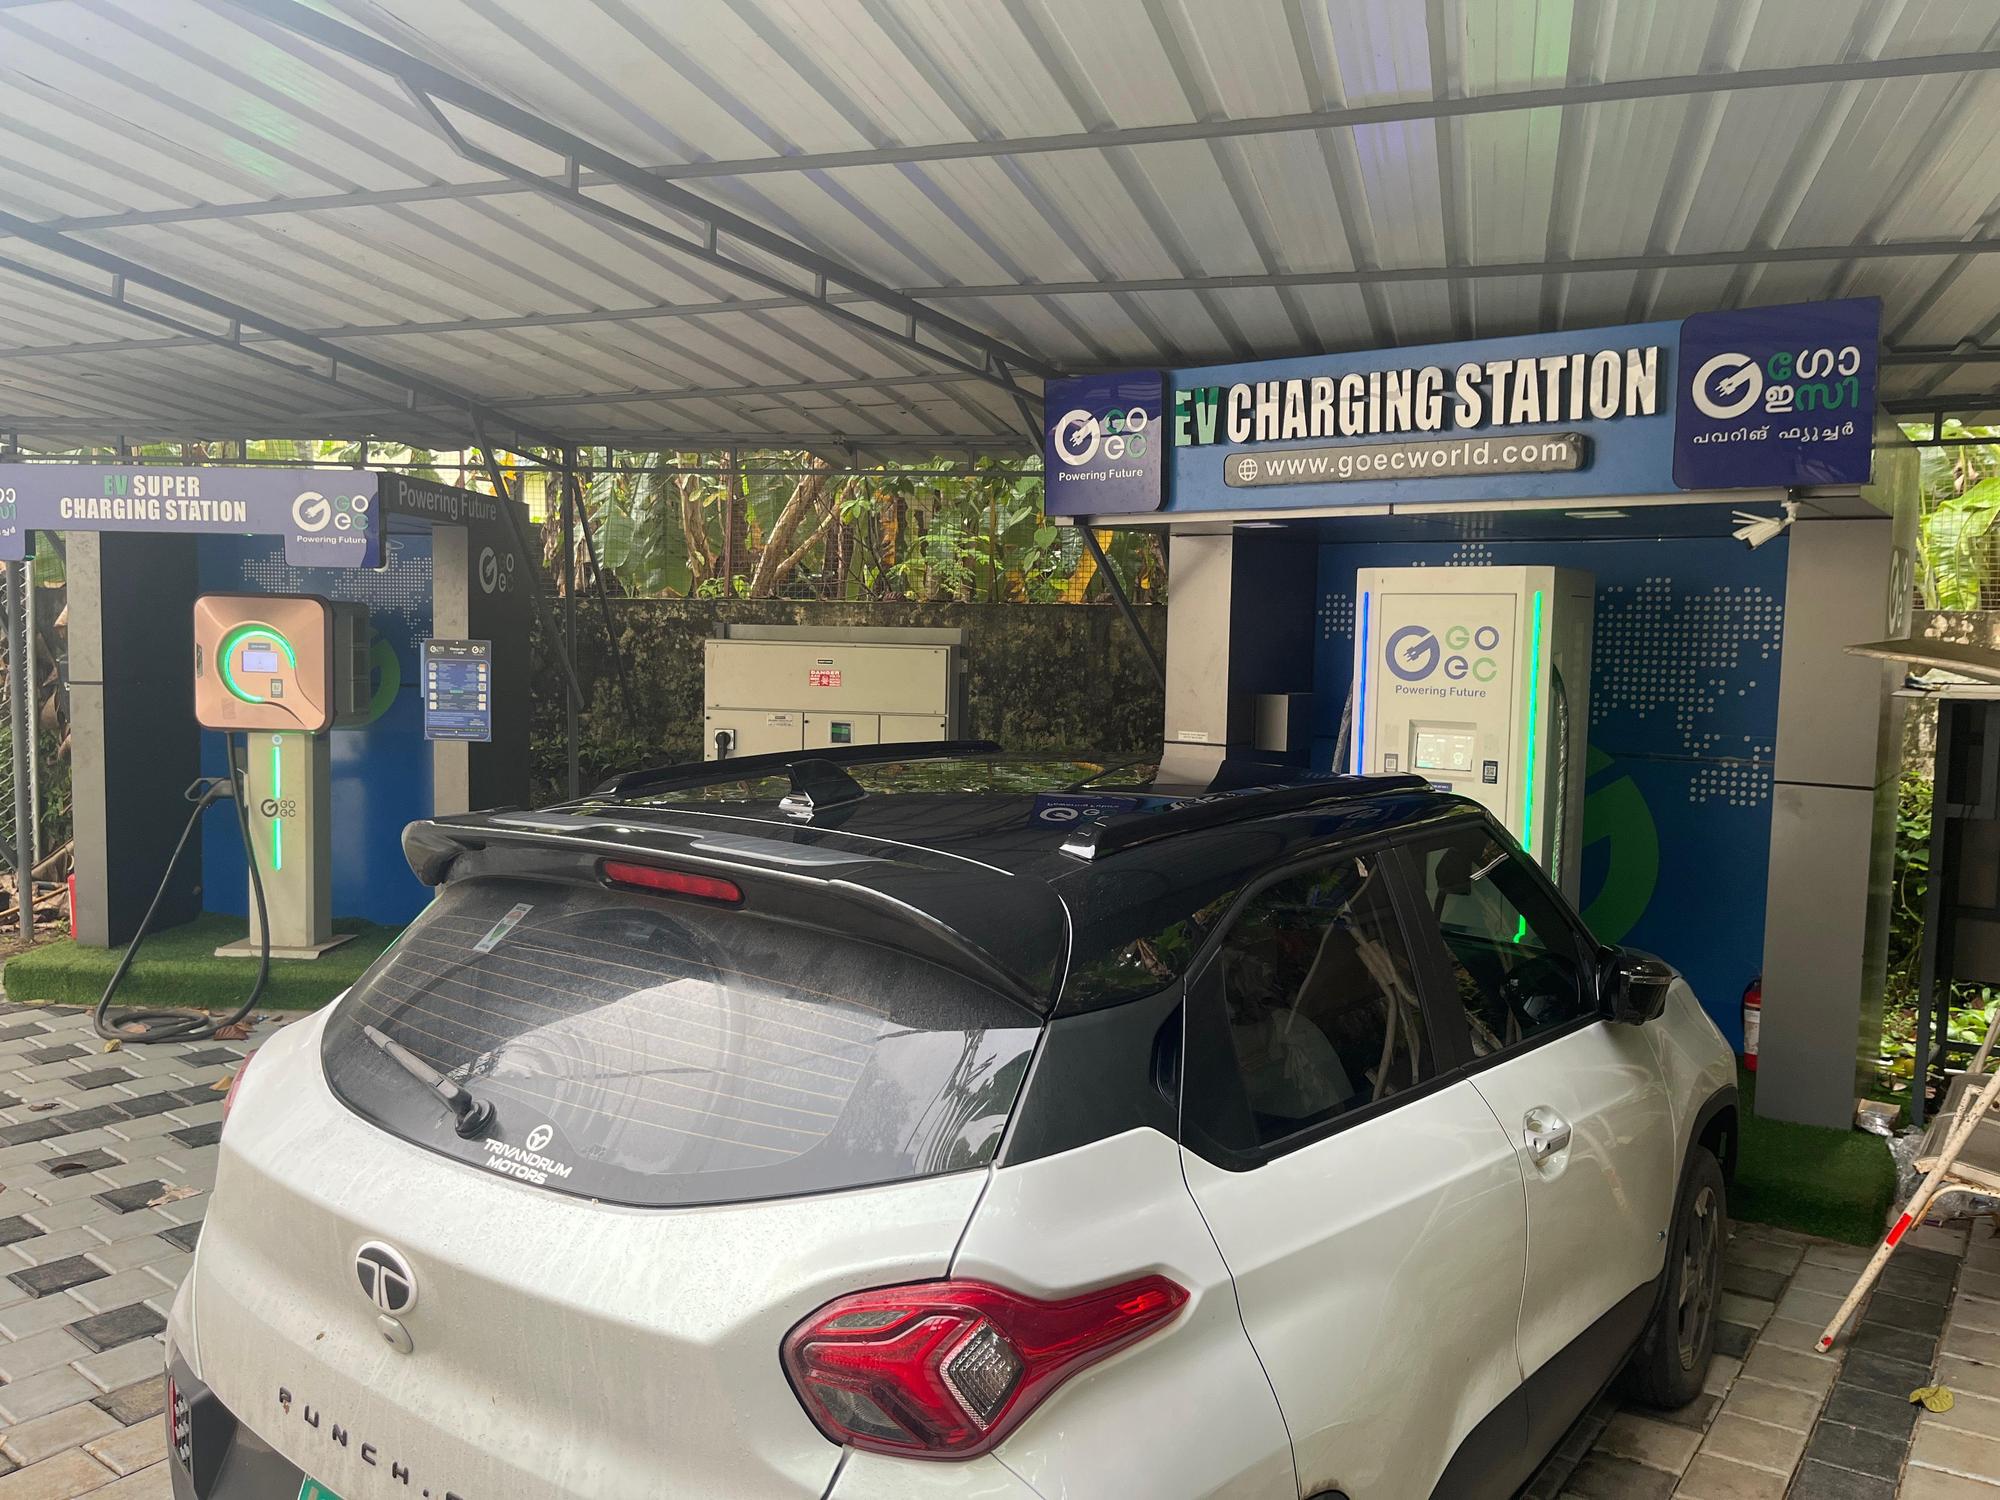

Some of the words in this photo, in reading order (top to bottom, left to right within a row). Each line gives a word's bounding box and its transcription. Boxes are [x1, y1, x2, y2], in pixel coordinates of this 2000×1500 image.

[1175, 386, 1220, 447] EV
[1226, 366, 1444, 444] CHARGING
[1454, 346, 1658, 429] STATION
[1265, 441, 1567, 478] www.goecworld.com
[104, 475, 128, 496] EV
[133, 475, 200, 497] SUPER
[1058, 471, 1106, 482] Powering
[1109, 469, 1144, 479] Future
[60, 497, 161, 520] CHARGING
[165, 500, 247, 522] STATION
[399, 480, 458, 520] Powering
[461, 493, 497, 520] Future
[297, 535, 337, 544] Powering
[338, 536, 367, 544] Future
[1395, 684, 1447, 698] Powering
[1449, 687, 1487, 698] Future
[483, 1138, 573, 1178] TRIVANDRUM
[486, 1155, 548, 1184] MOTORS
